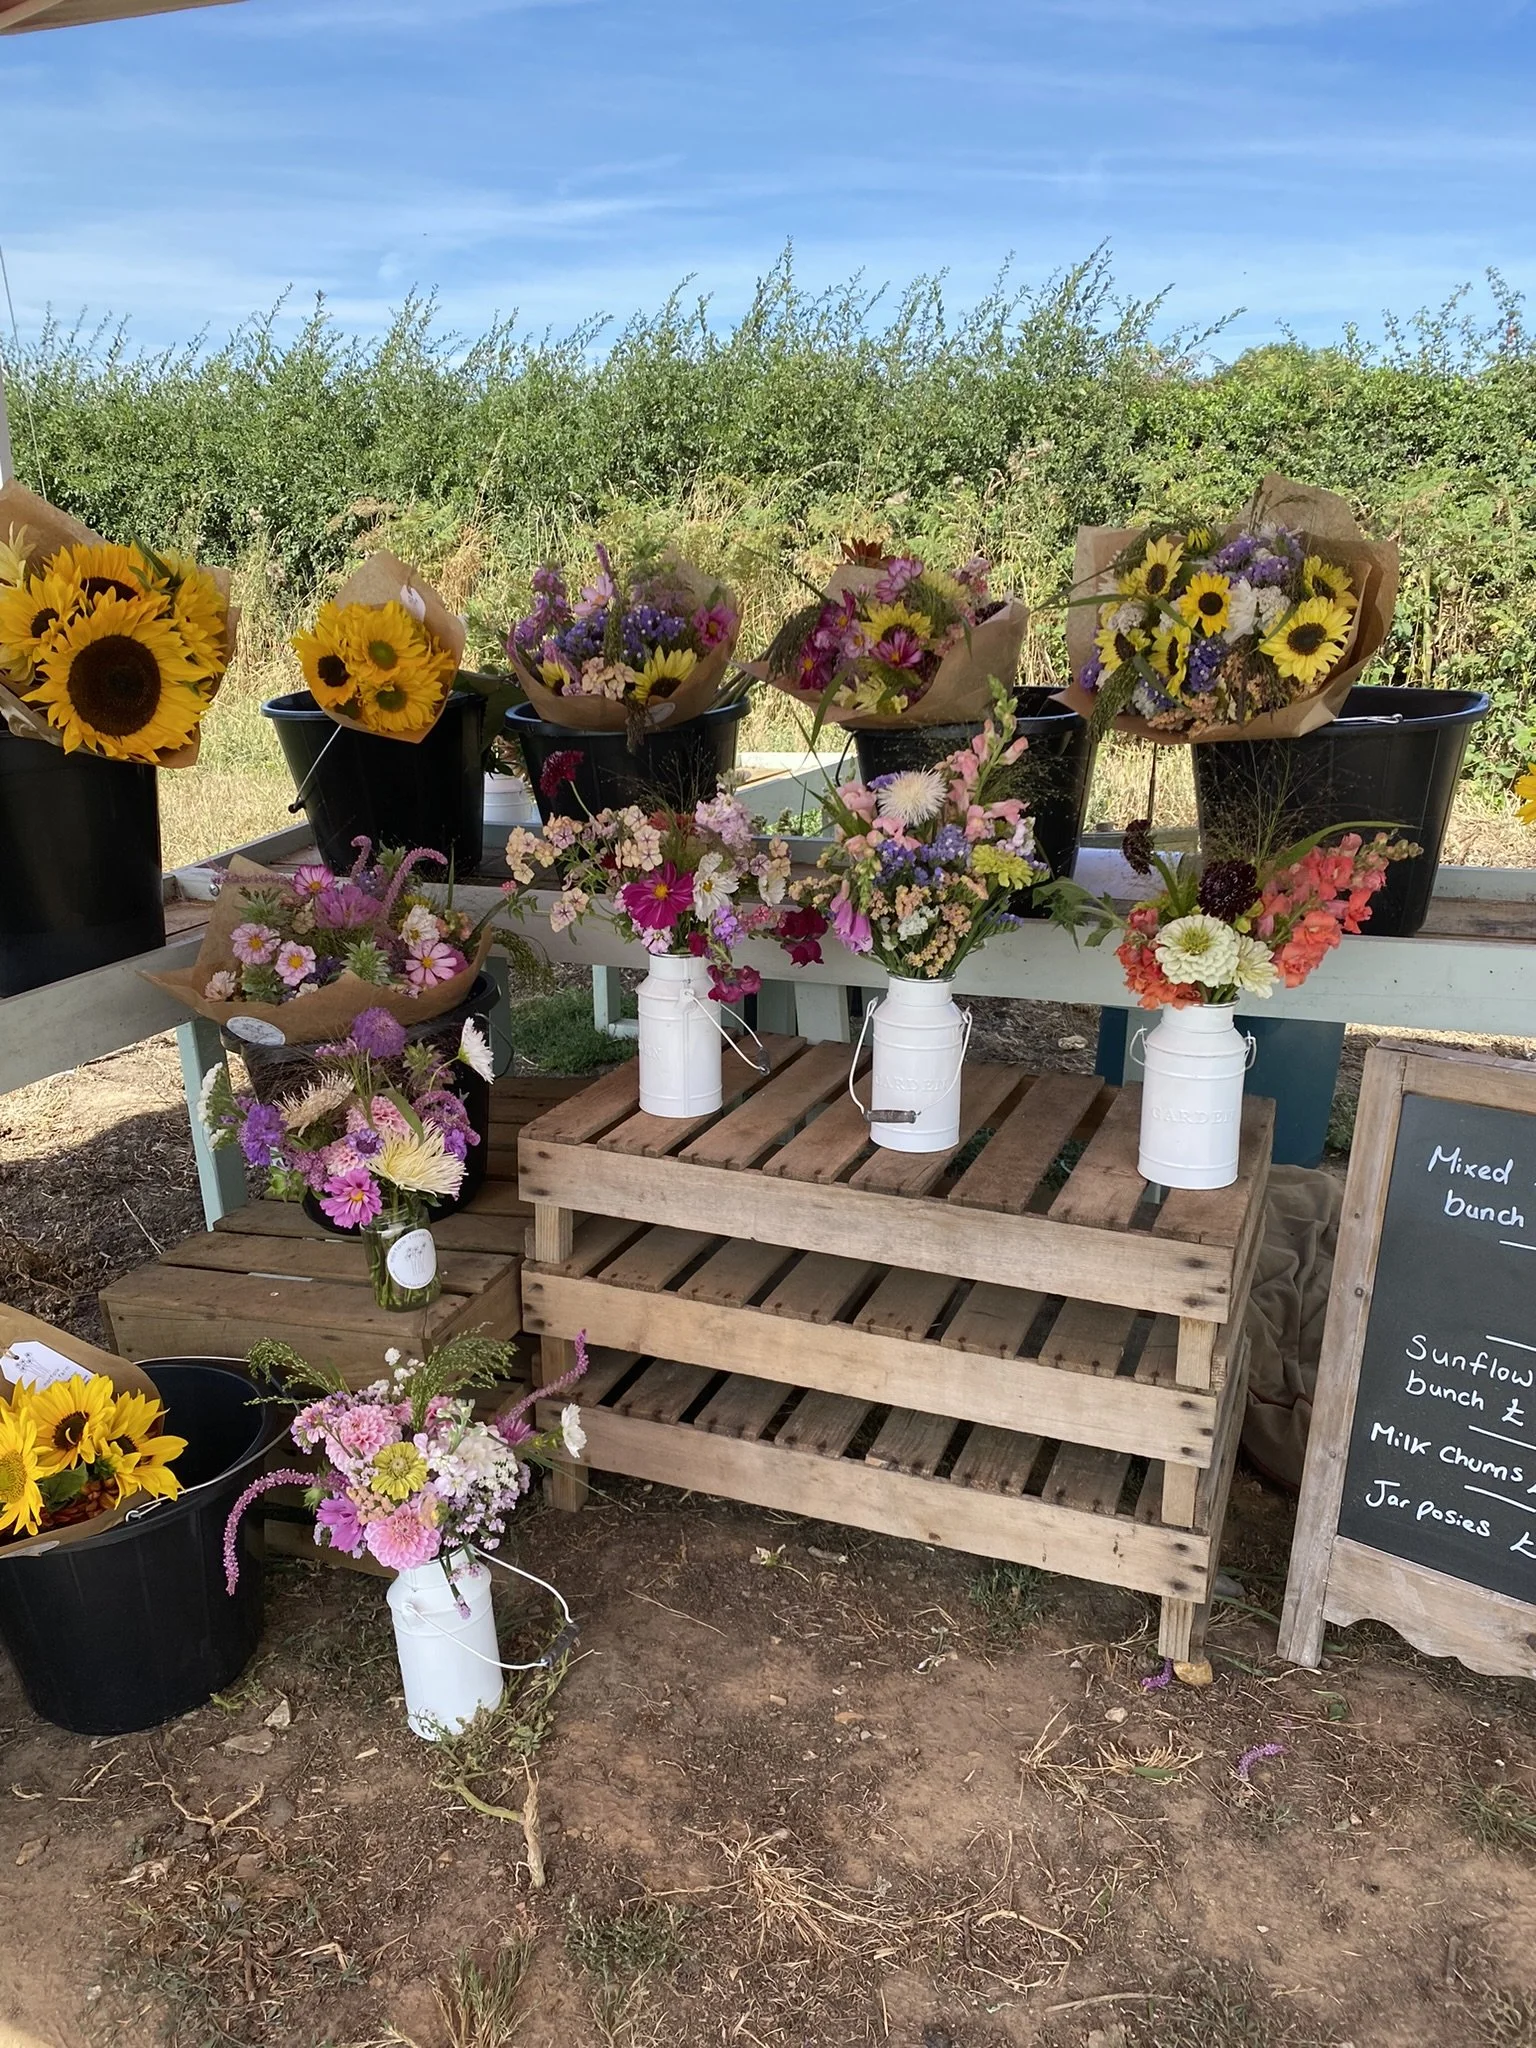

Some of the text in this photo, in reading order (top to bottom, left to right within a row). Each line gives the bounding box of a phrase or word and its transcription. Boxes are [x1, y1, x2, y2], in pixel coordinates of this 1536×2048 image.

[1427, 1144, 1514, 1185] Mixed
[1443, 1188, 1525, 1228] bunch
[1405, 1334, 1534, 1388] Sunflow
[1405, 1369, 1525, 1427] bunch £
[1370, 1422, 1524, 1482] Milk Churns
[1365, 1479, 1411, 1508] Jar
